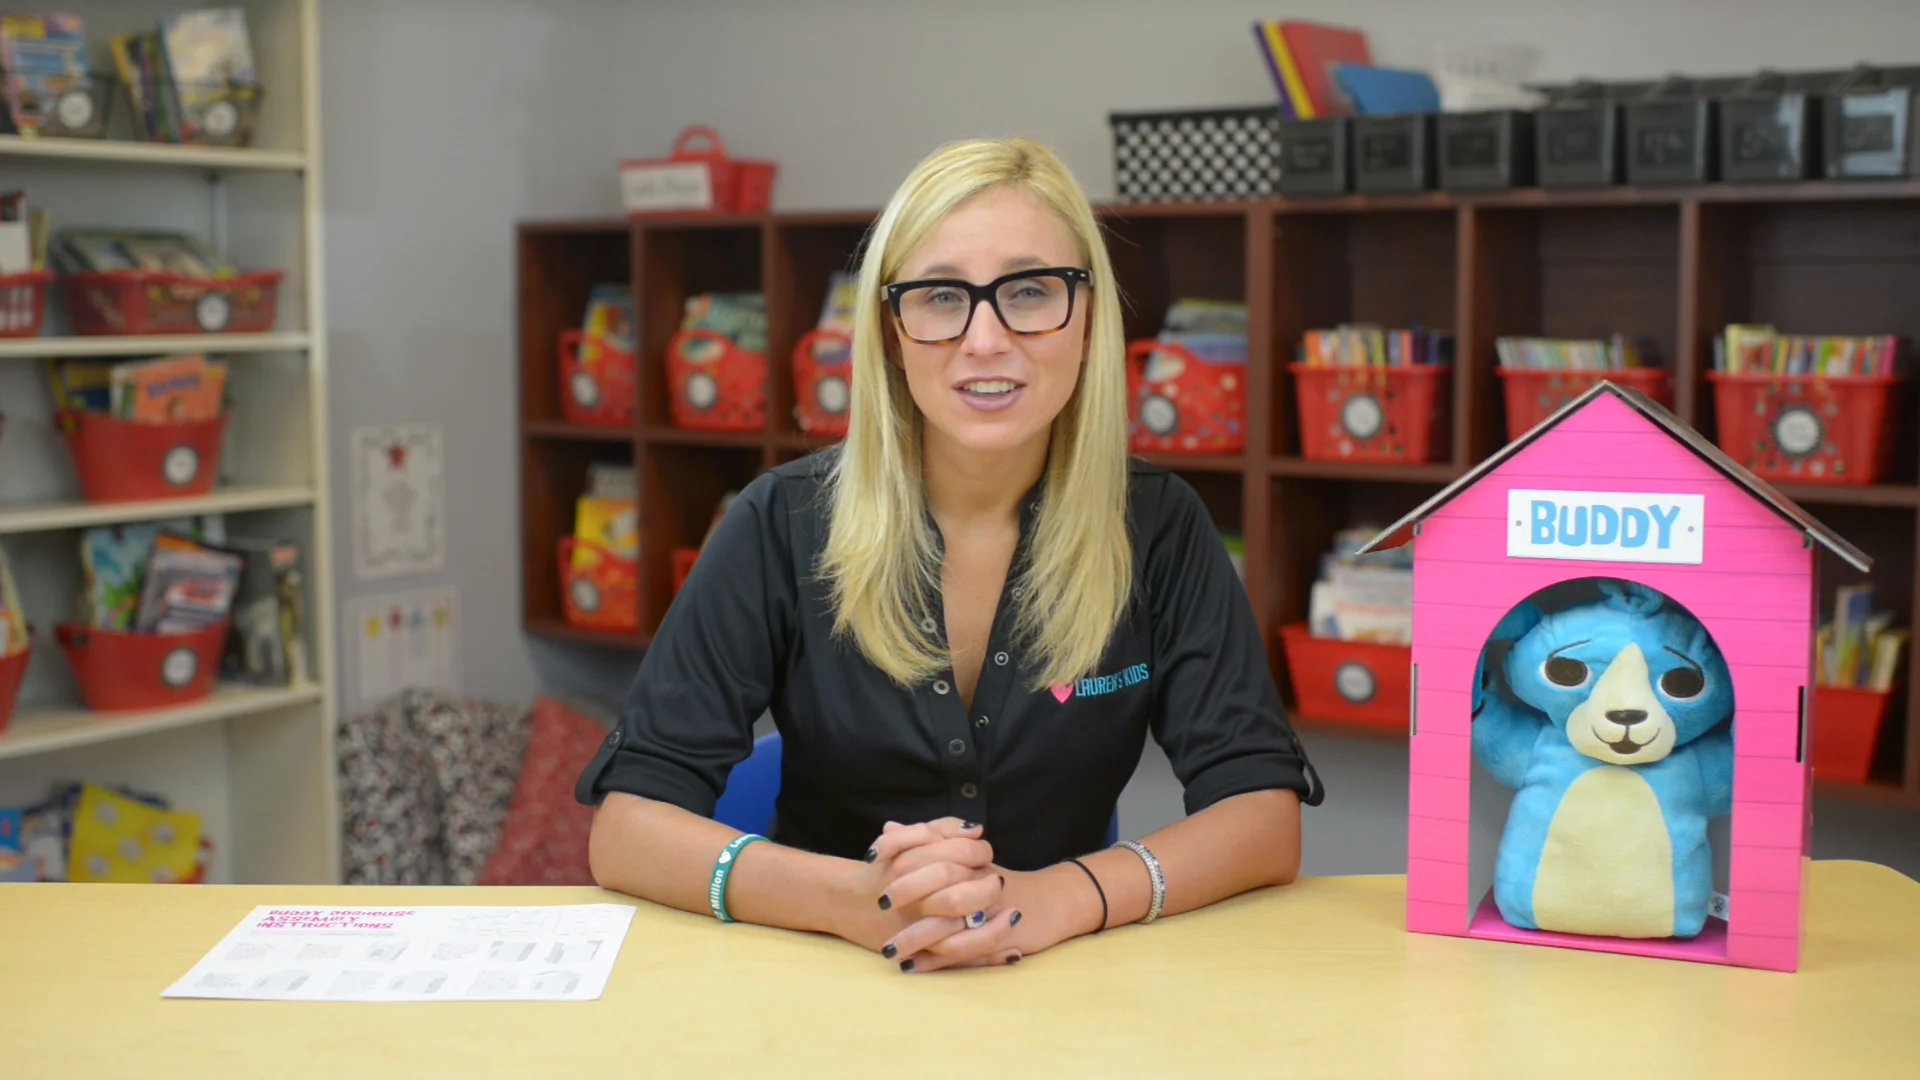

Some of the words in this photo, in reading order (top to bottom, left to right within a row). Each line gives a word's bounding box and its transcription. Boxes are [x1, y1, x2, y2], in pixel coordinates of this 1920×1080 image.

[1530, 499, 1681, 550] BUDDY
[1122, 663, 1150, 687] KIDS
[710, 869, 725, 910] Million
